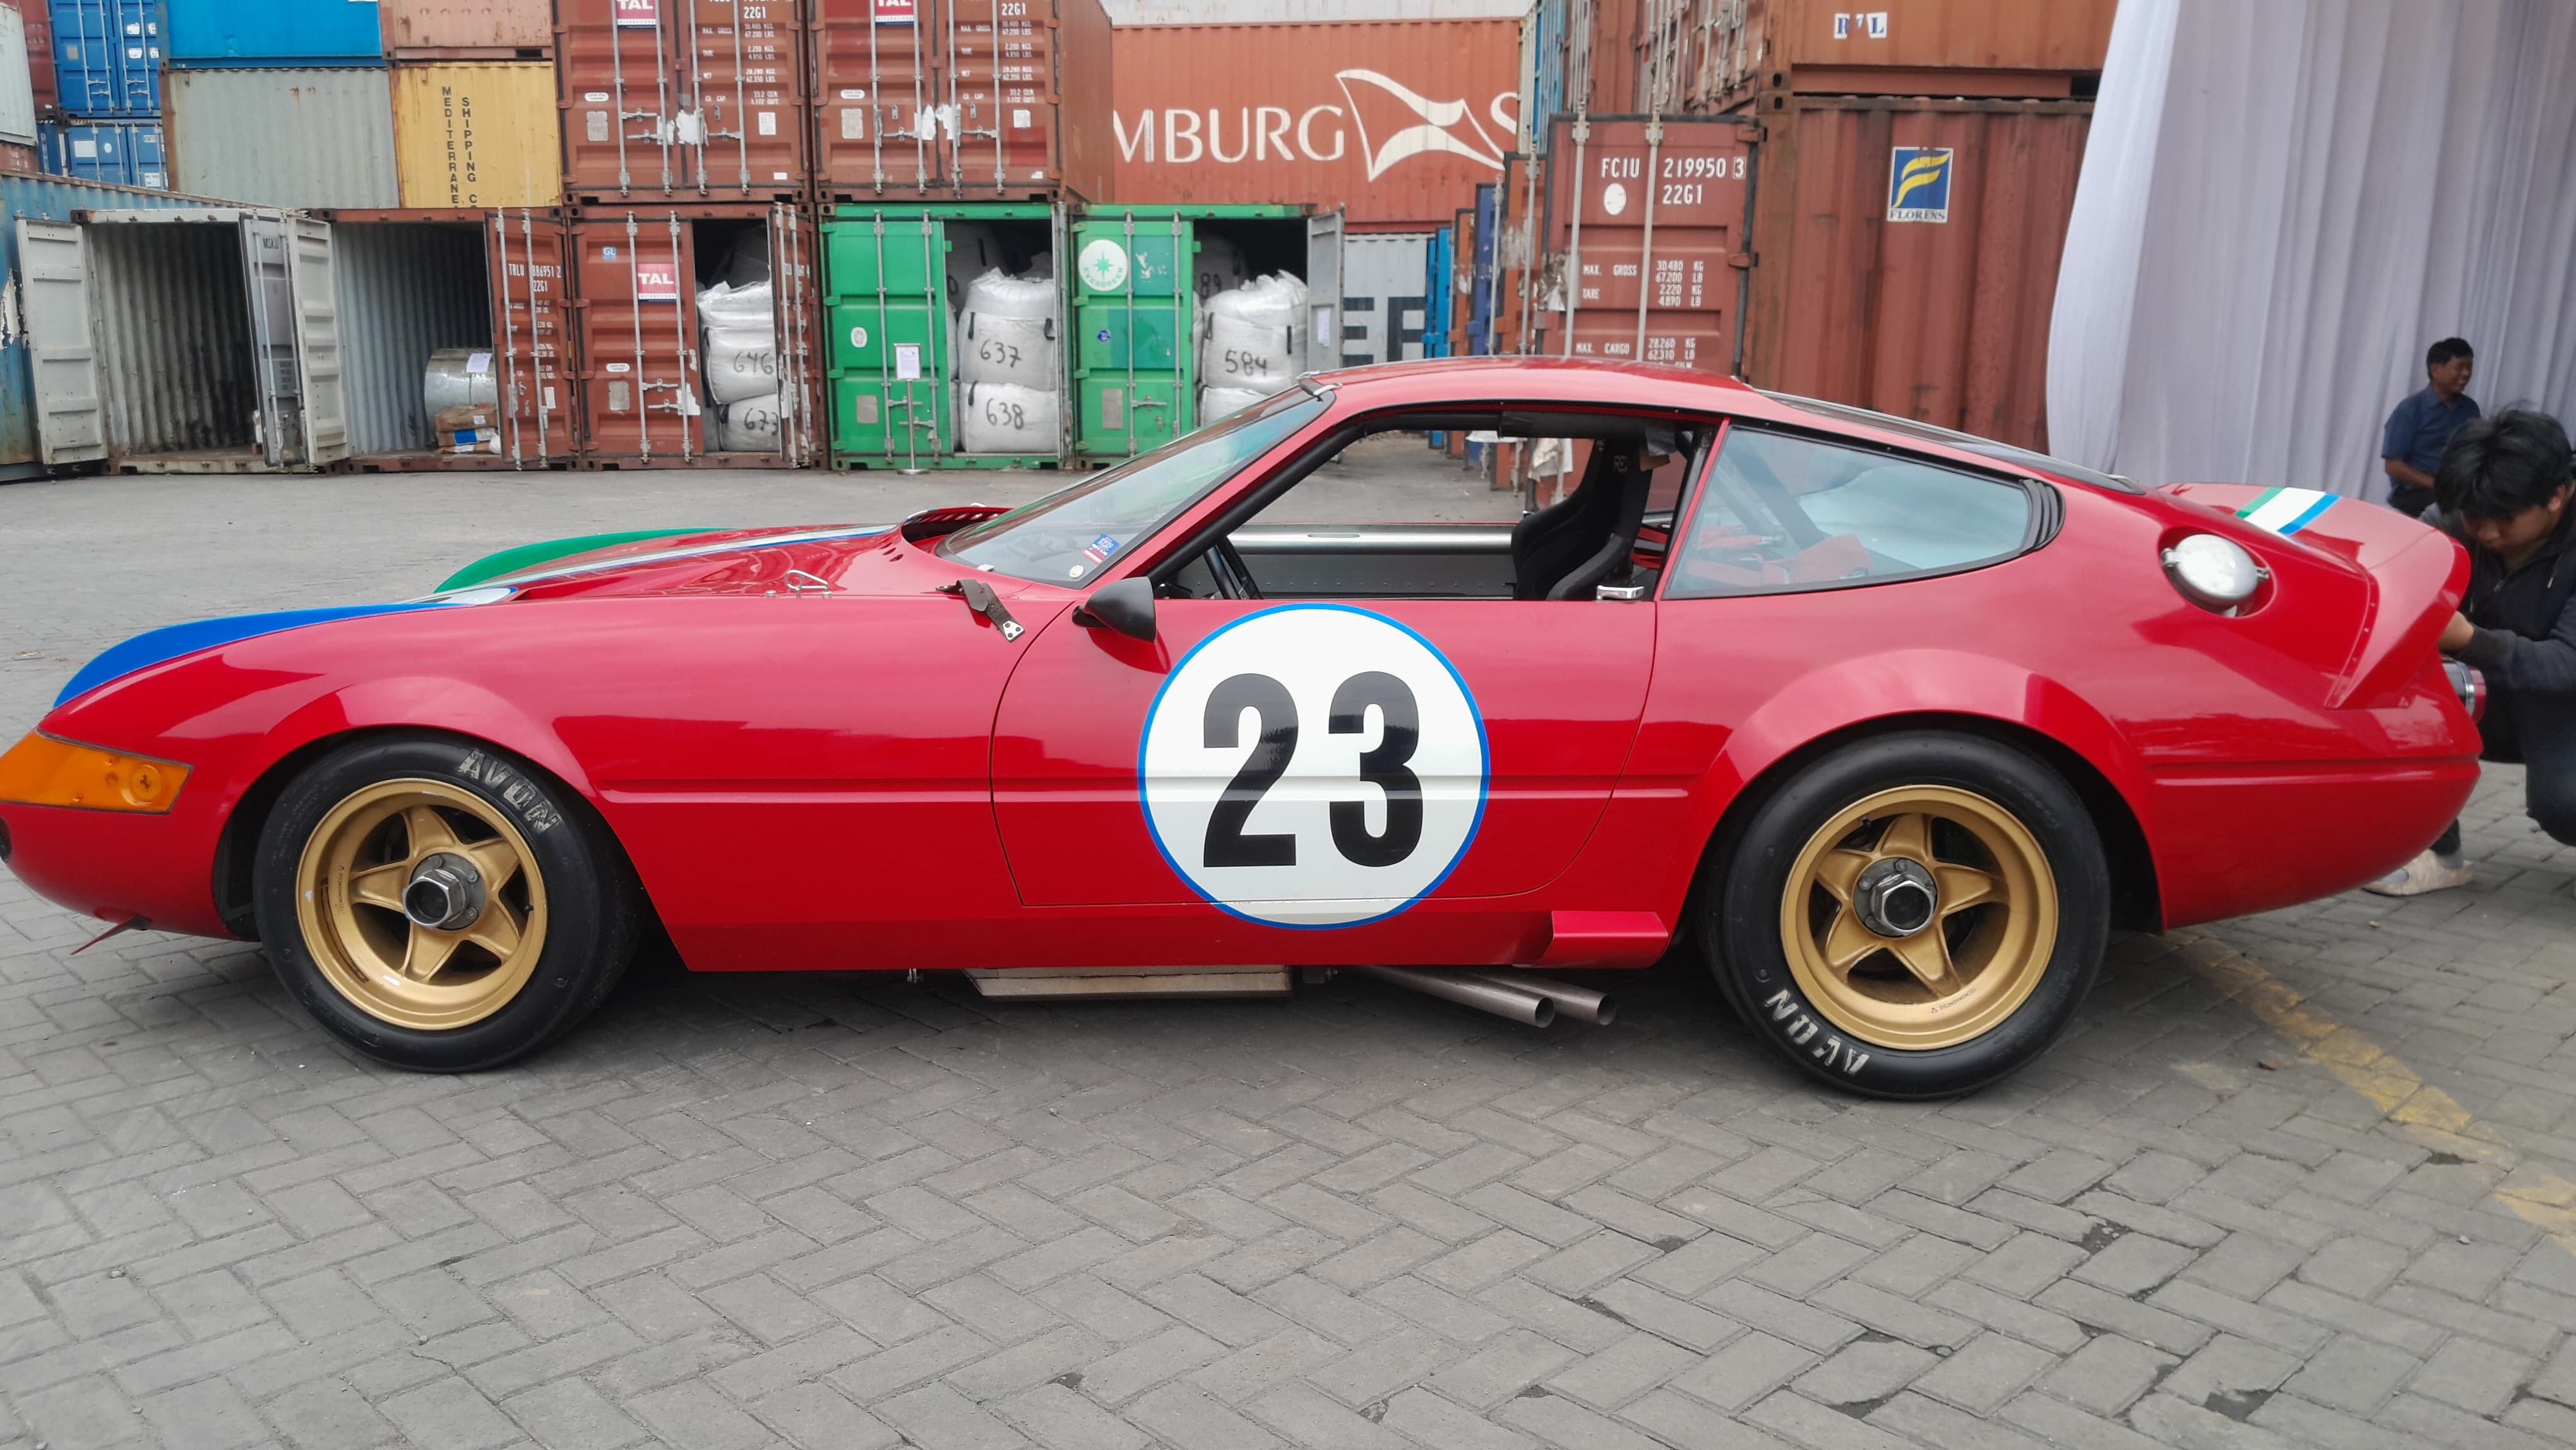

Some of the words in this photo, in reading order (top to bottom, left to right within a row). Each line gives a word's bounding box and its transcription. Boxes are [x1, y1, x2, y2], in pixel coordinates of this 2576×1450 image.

[744, 6, 766, 18] 22G1
[1001, 3, 1026, 16] 22G1
[442, 87, 459, 208] MEDITERRANE
[462, 97, 476, 182] SHIPPING
[1601, 157, 1640, 178] FCIU
[1663, 157, 1726, 178] 219950
[1735, 158, 1744, 178] 3
[1662, 184, 1702, 205] 22G1
[1890, 211, 1945, 219] FLORENS
[604, 247, 616, 255] GL
[508, 263, 524, 276] TRLU
[1583, 264, 1602, 276] MAX.
[1613, 264, 1637, 277] GROSS
[1692, 272, 1703, 284] LB
[638, 273, 674, 284] TAL
[1690, 296, 1701, 307] LB
[981, 339, 1022, 368] 637
[1575, 342, 1594, 354] MAX.
[1604, 343, 1630, 354] CARGO
[1685, 349, 1695, 360] LB
[734, 352, 773, 375] 646
[1225, 349, 1267, 377] 584
[986, 398, 1024, 429] 638
[1203, 671, 1424, 868] 23
[456, 748, 561, 836] AVON
[1764, 989, 1870, 1075] AVON
